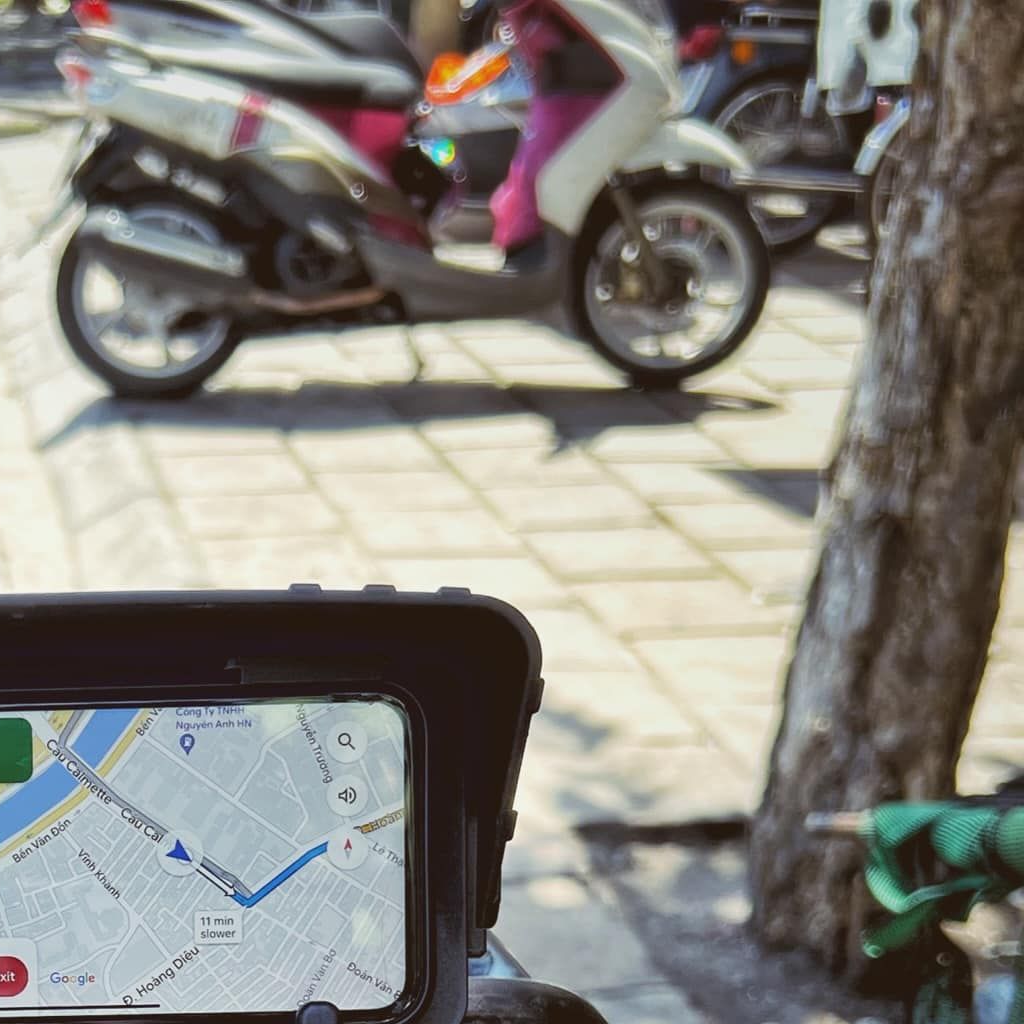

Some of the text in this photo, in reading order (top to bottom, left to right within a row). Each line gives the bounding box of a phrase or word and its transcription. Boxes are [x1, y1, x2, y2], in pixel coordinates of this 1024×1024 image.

[199, 916, 234, 926] 11 min
[200, 928, 236, 939] slower
[50, 971, 96, 986] Google
